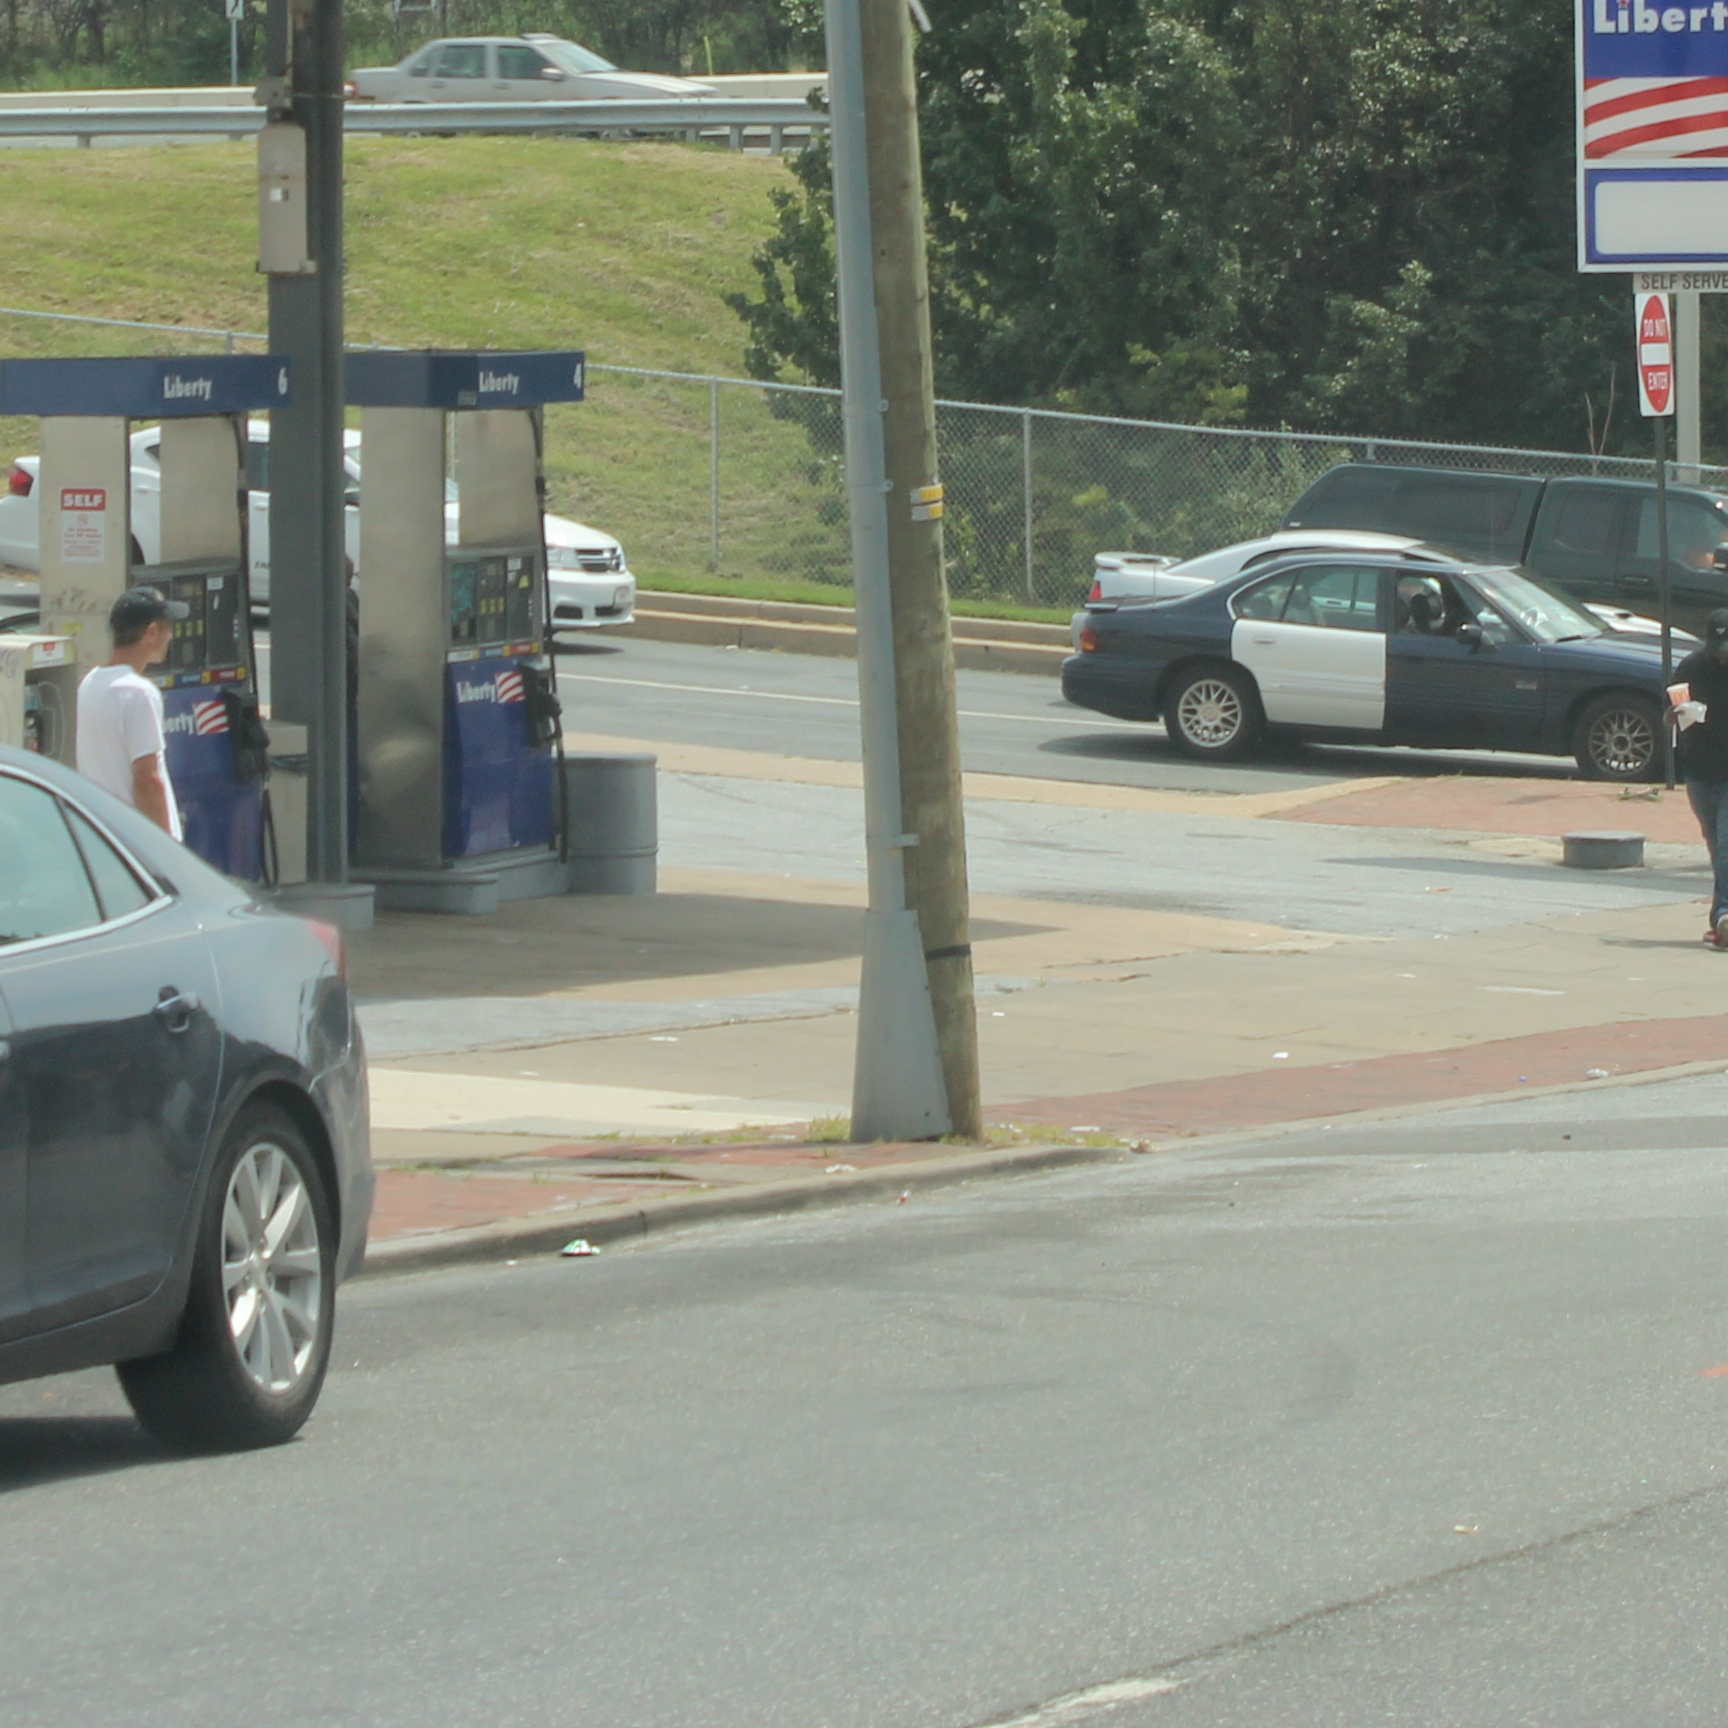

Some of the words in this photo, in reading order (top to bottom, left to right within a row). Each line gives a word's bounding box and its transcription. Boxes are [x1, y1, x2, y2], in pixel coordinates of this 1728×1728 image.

[1641, 274, 1677, 290] SELF
[1643, 318, 1654, 337] DO
[1655, 318, 1667, 337] NOT
[163, 374, 213, 401] Liberty
[277, 368, 288, 395] 6
[478, 370, 520, 394] Liberty
[573, 363, 583, 390] 4
[1647, 370, 1669, 391] ENTER
[63, 493, 104, 508] SELF
[455, 680, 497, 704] Liberty
